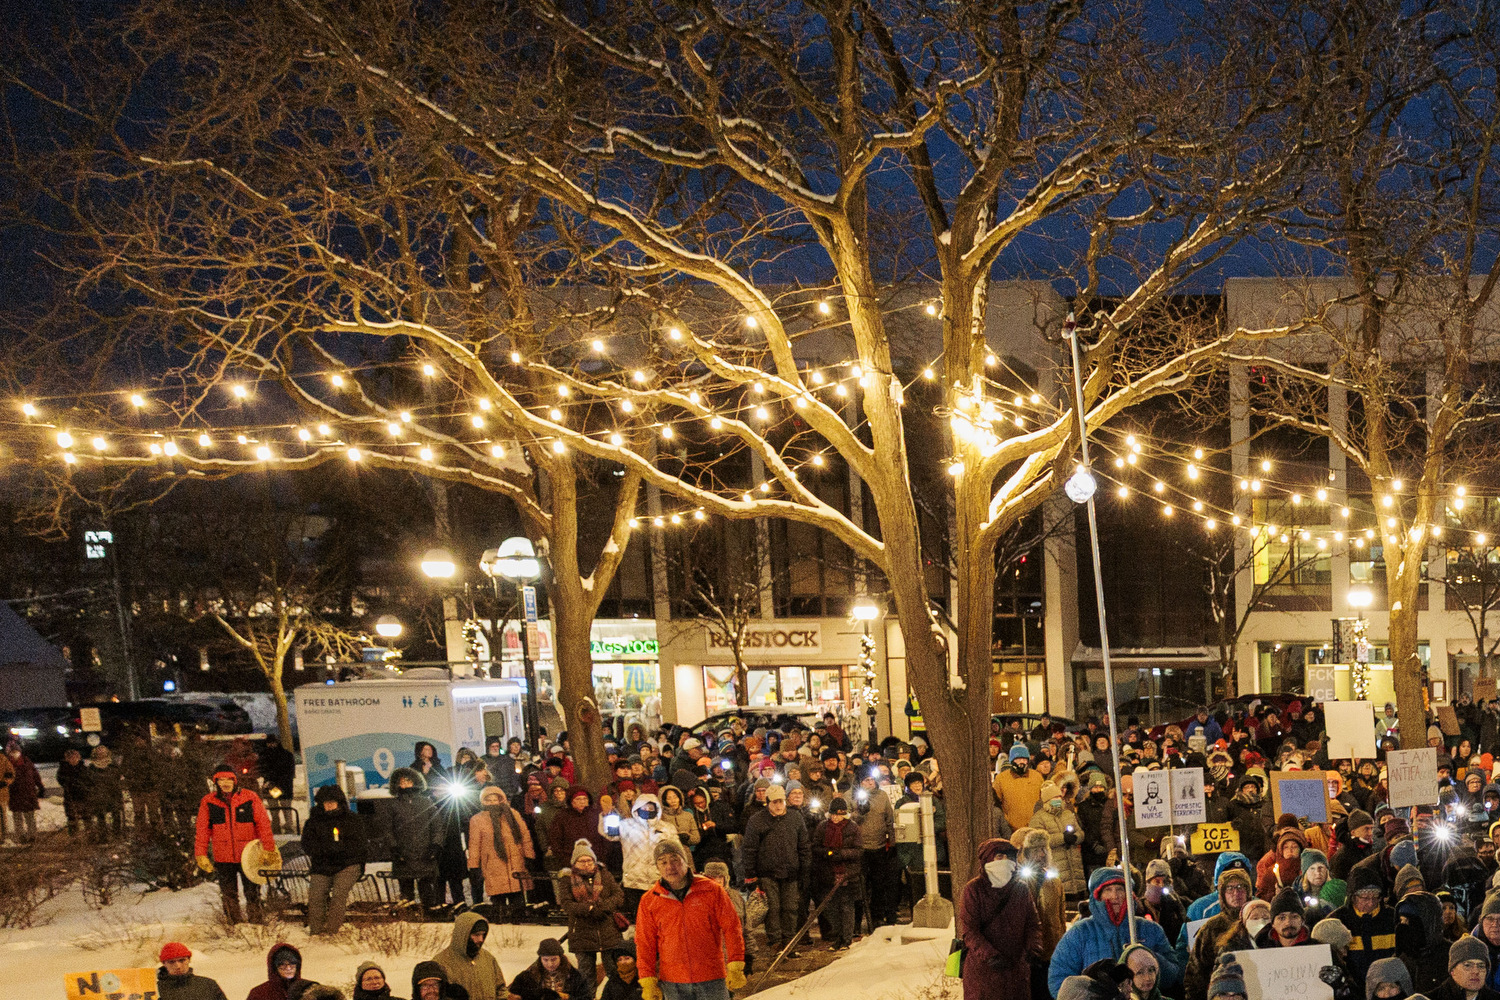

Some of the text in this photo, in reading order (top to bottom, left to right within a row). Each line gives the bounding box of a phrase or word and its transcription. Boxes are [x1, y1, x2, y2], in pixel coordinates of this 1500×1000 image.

[709, 629, 818, 648] RAGSTOCK
[590, 640, 659, 655] AGSTOC
[1308, 668, 1335, 681] FCK
[1310, 688, 1334, 700] ICE
[303, 698, 380, 707] FREE BATHROOM
[1400, 751, 1431, 765] I AM
[1173, 809, 1202, 817] TERRORIST
[1202, 828, 1229, 840] ICE
[1204, 839, 1233, 852] OUT
